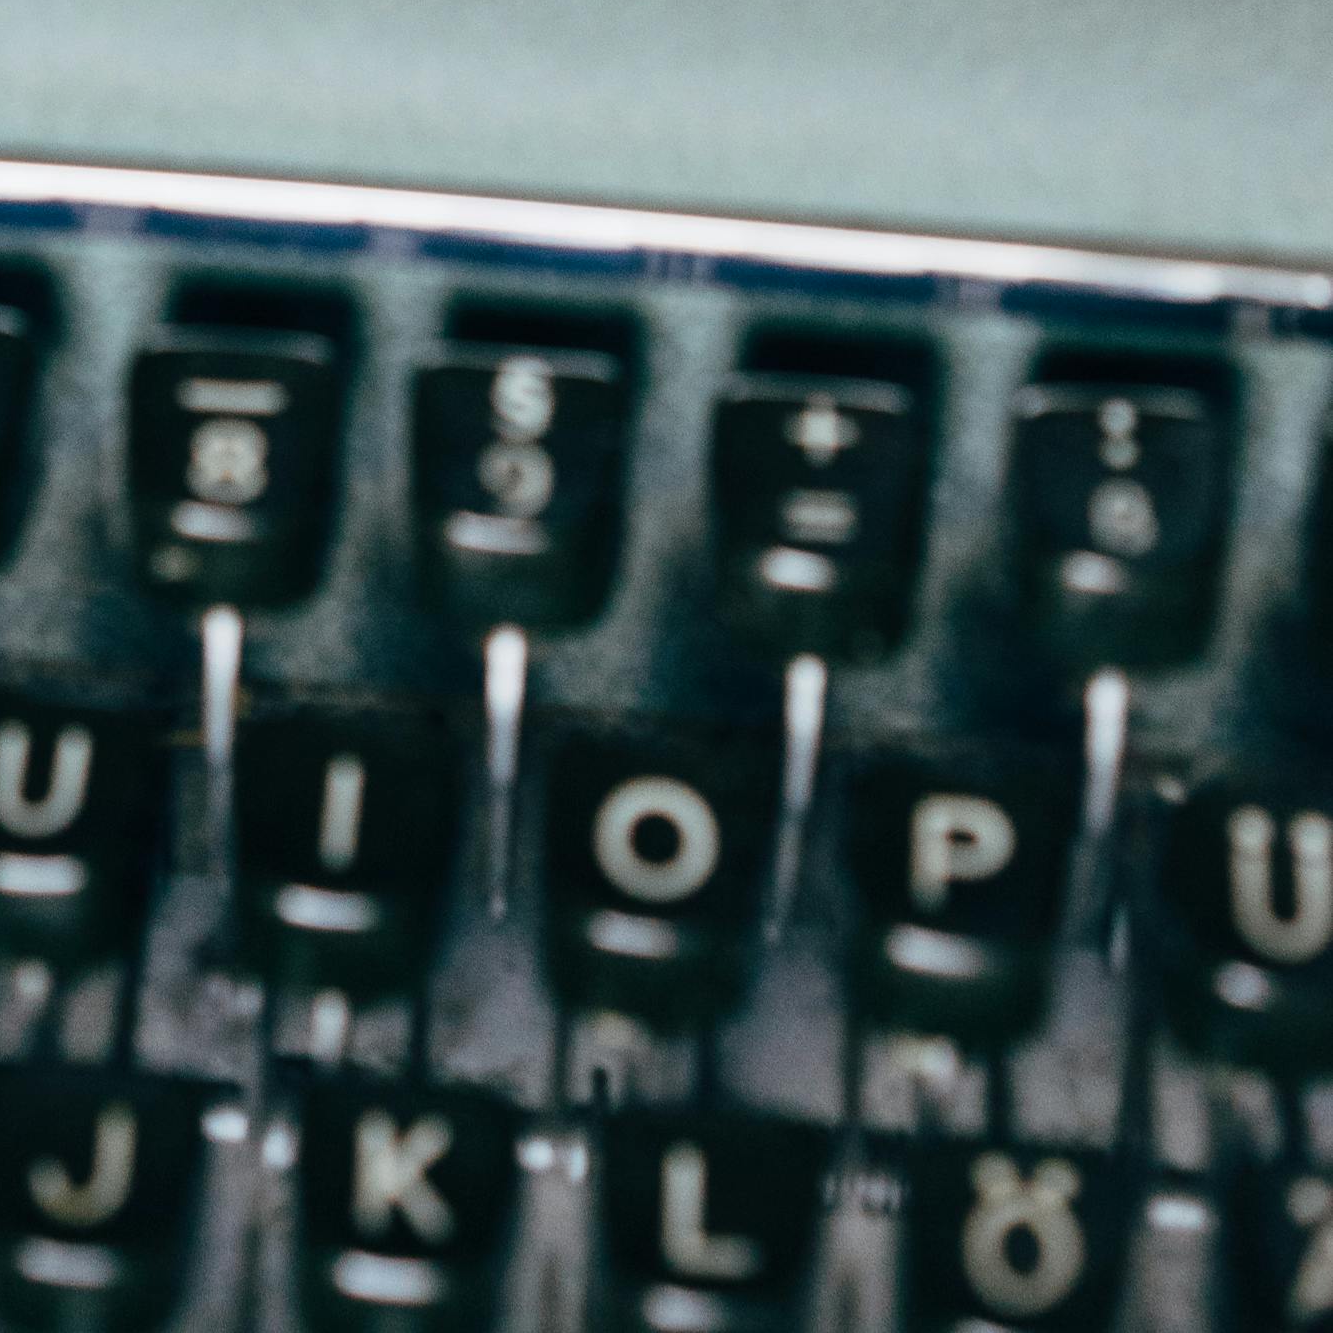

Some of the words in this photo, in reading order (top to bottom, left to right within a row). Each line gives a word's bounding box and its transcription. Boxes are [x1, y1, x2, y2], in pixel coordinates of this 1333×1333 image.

[319, 754, 365, 872] I
[593, 775, 721, 902] O
[909, 792, 1017, 912] P
[29, 1102, 135, 1228] J
[352, 1112, 452, 1240] K
[660, 1144, 761, 1281] L
